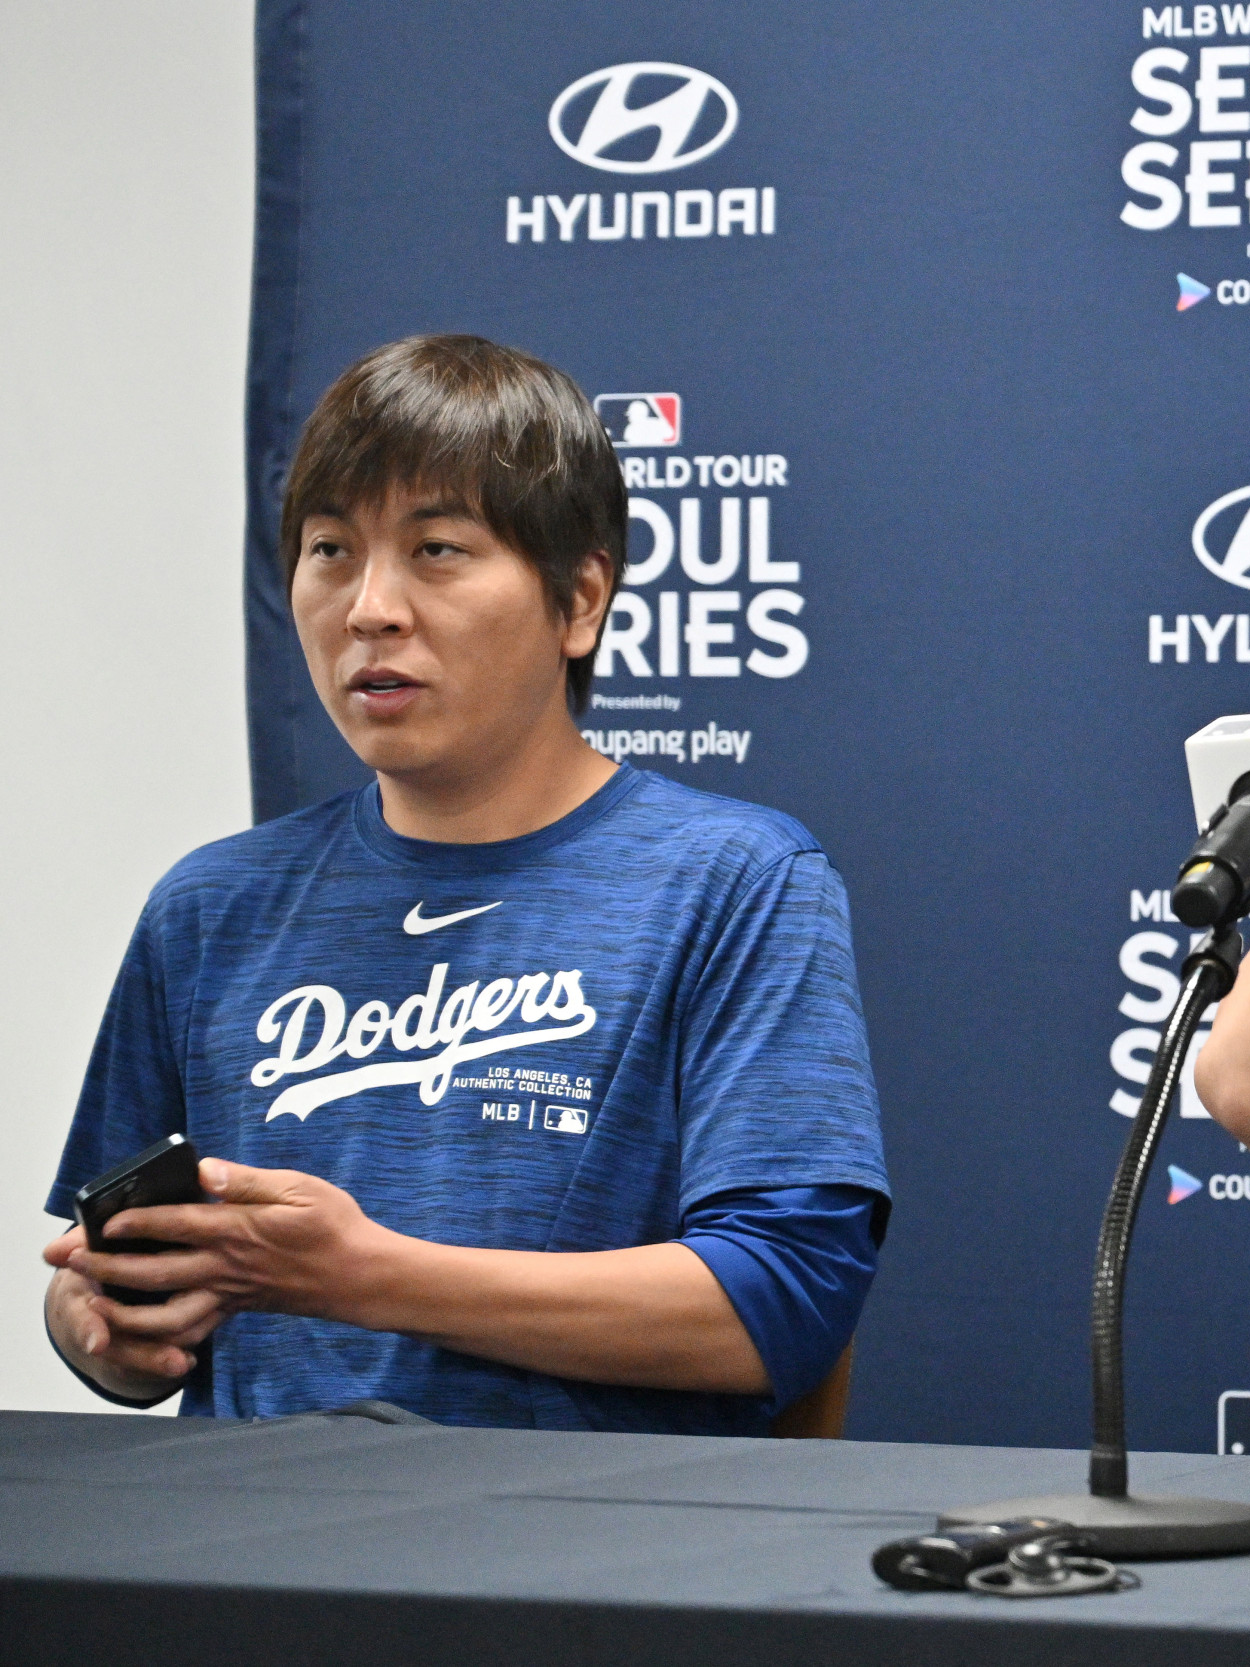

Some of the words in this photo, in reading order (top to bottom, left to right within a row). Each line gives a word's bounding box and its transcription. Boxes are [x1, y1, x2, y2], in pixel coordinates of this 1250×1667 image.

[1142, 6, 1218, 38] MLB
[506, 187, 776, 243] HYUNDAI
[620, 456, 692, 489] RLD
[694, 454, 788, 487] TOUR
[622, 497, 800, 586] OUL
[593, 589, 810, 679] RIES
[591, 693, 662, 710] Presented
[663, 694, 681, 712] by
[580, 729, 686, 763] oupang
[691, 721, 751, 764] play
[1130, 889, 1181, 923] ML
[250, 963, 596, 1122] Dodgers
[452, 1077, 515, 1090] AUTHENTIC
[518, 1082, 592, 1100] COLLECTION
[488, 1067, 510, 1079] LOS
[575, 1076, 592, 1089] CA
[482, 1102, 520, 1121] MLB
